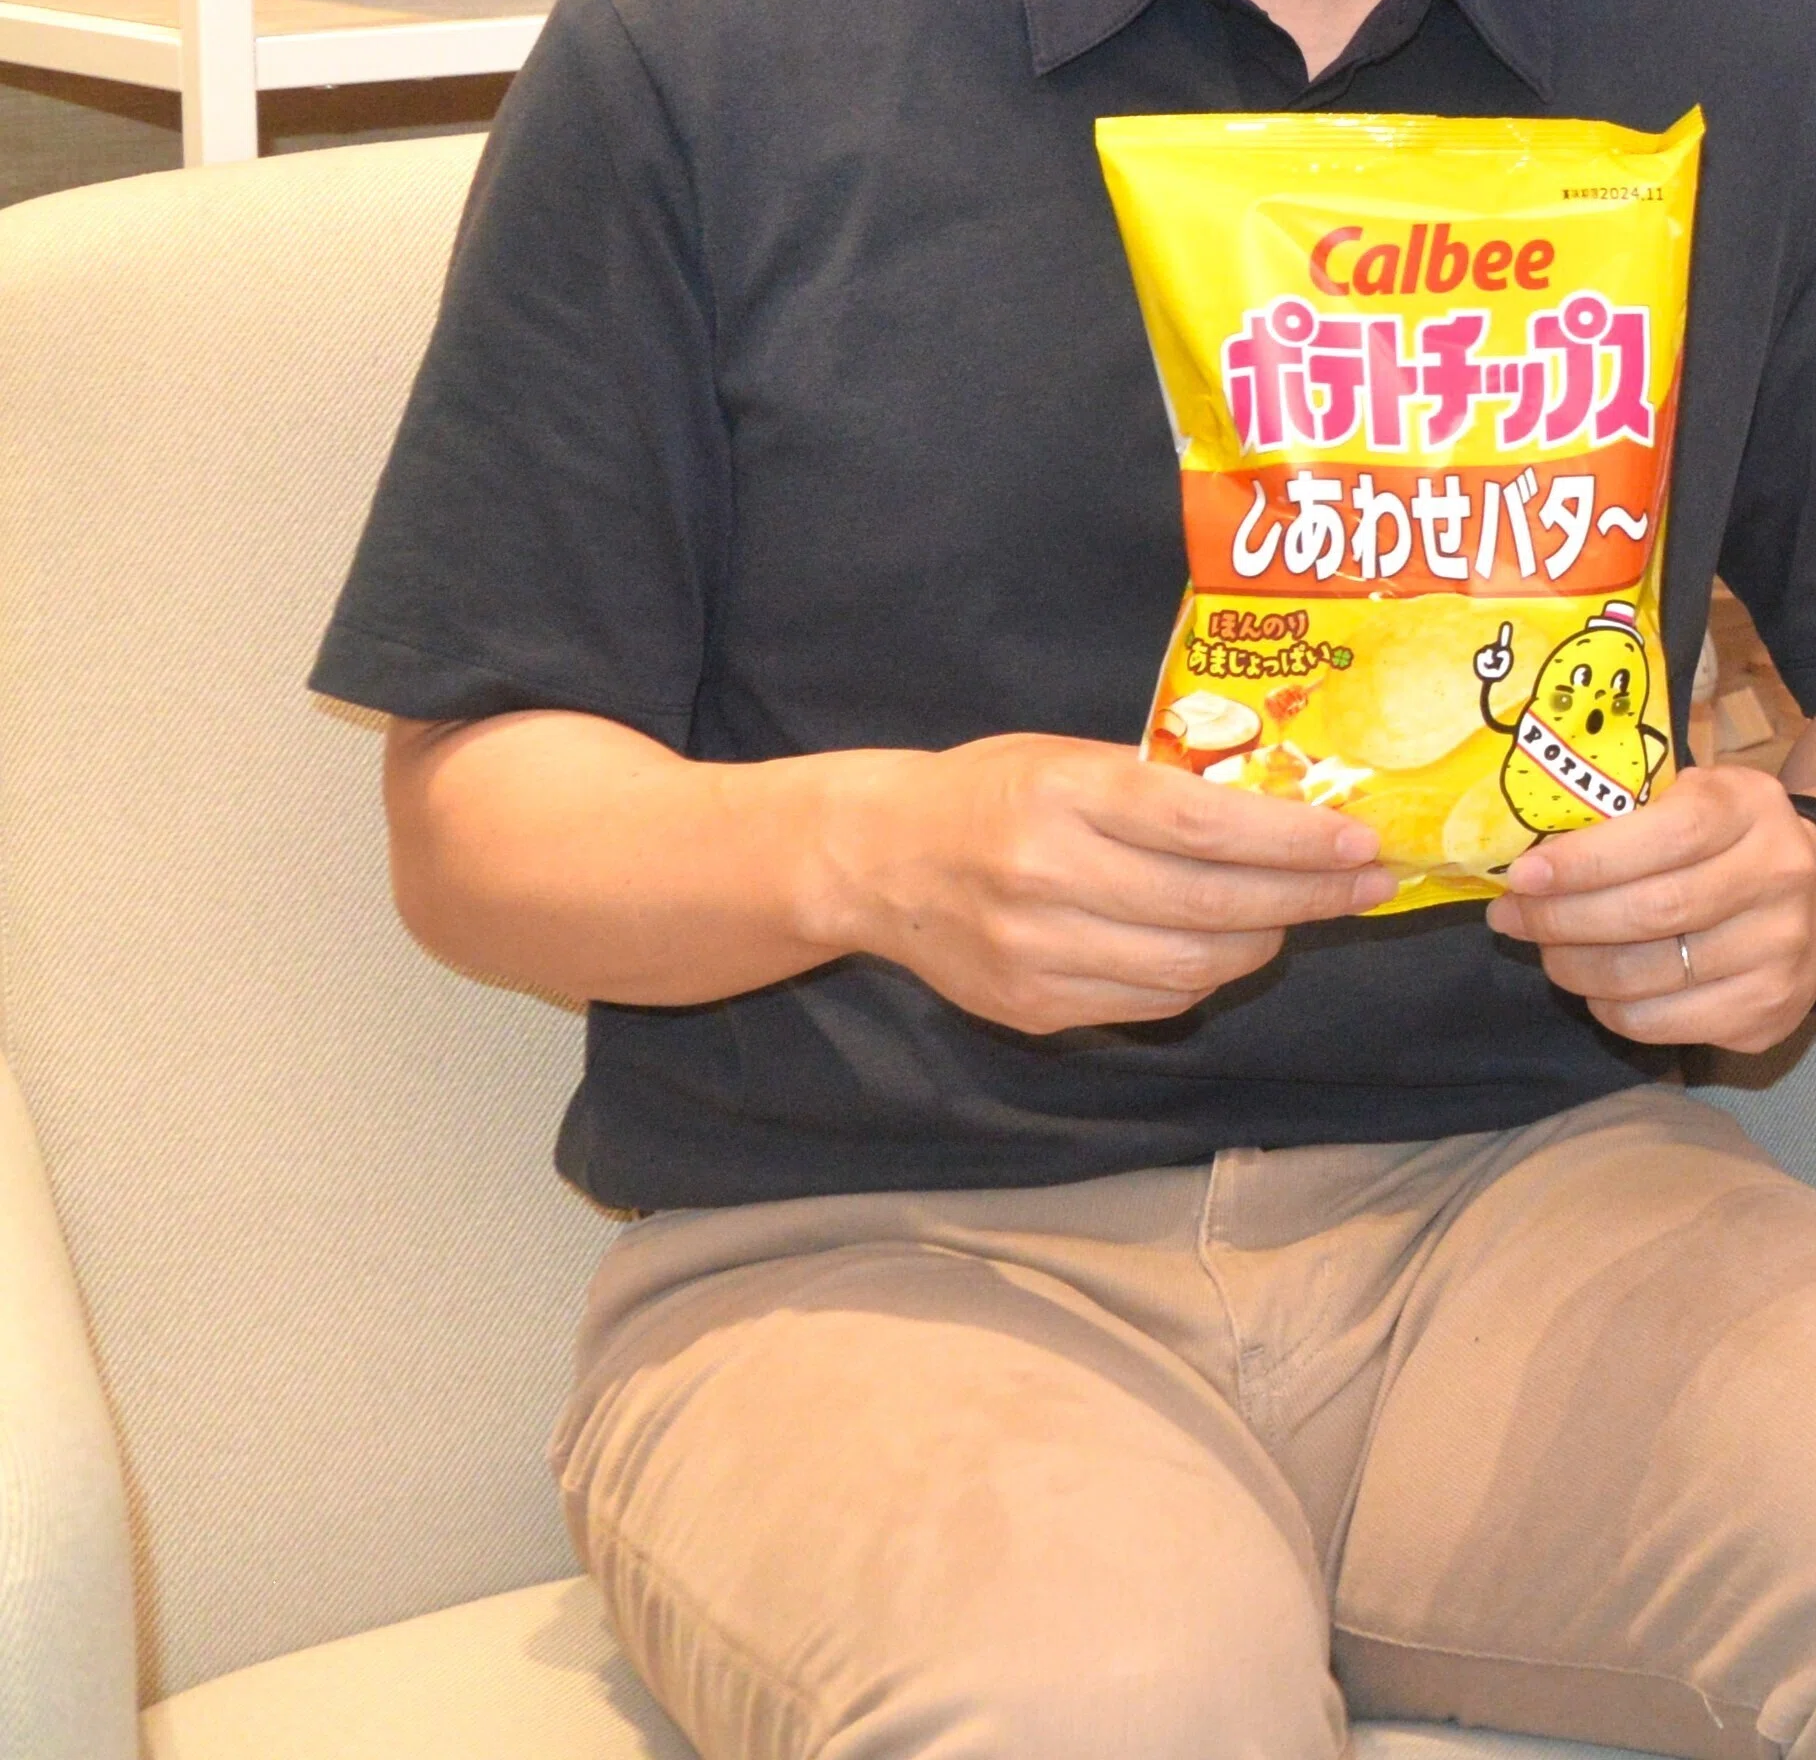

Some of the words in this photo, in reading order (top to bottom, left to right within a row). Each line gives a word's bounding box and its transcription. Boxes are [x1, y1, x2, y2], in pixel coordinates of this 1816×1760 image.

[1308, 224, 1556, 298] Calbee
[1222, 296, 1656, 452] ポテトチップス
[1231, 467, 1649, 582] しあわせバタ〜
[1187, 638, 1333, 678] あまじょっぱい
[1208, 609, 1309, 642] ほんのり
[1521, 723, 1630, 814] POTATO
